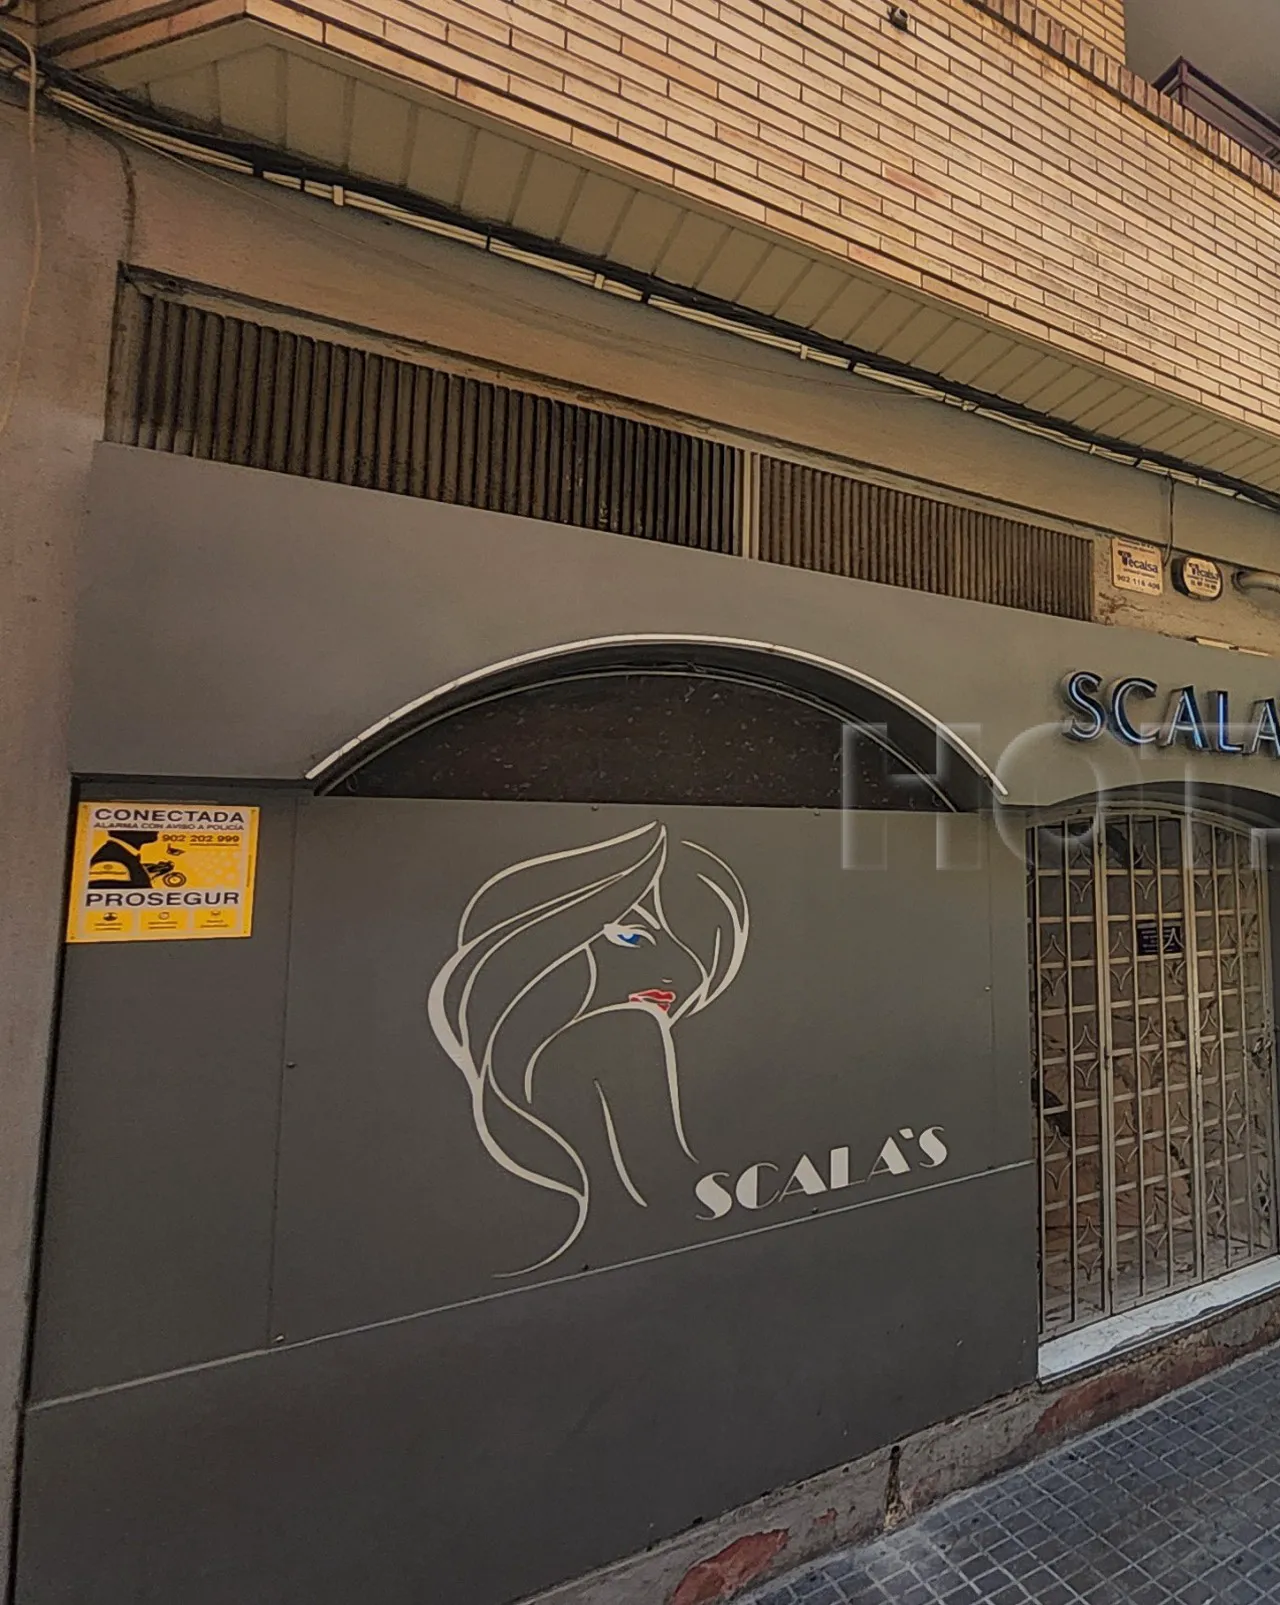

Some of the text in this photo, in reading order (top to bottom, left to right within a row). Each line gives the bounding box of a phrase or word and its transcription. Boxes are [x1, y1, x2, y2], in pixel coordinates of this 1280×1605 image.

[1117, 550, 1158, 573] Tecalsa
[94, 808, 245, 823] CONECTADA
[162, 834, 240, 842] 902 202 999
[85, 891, 240, 907] PROSEGUR
